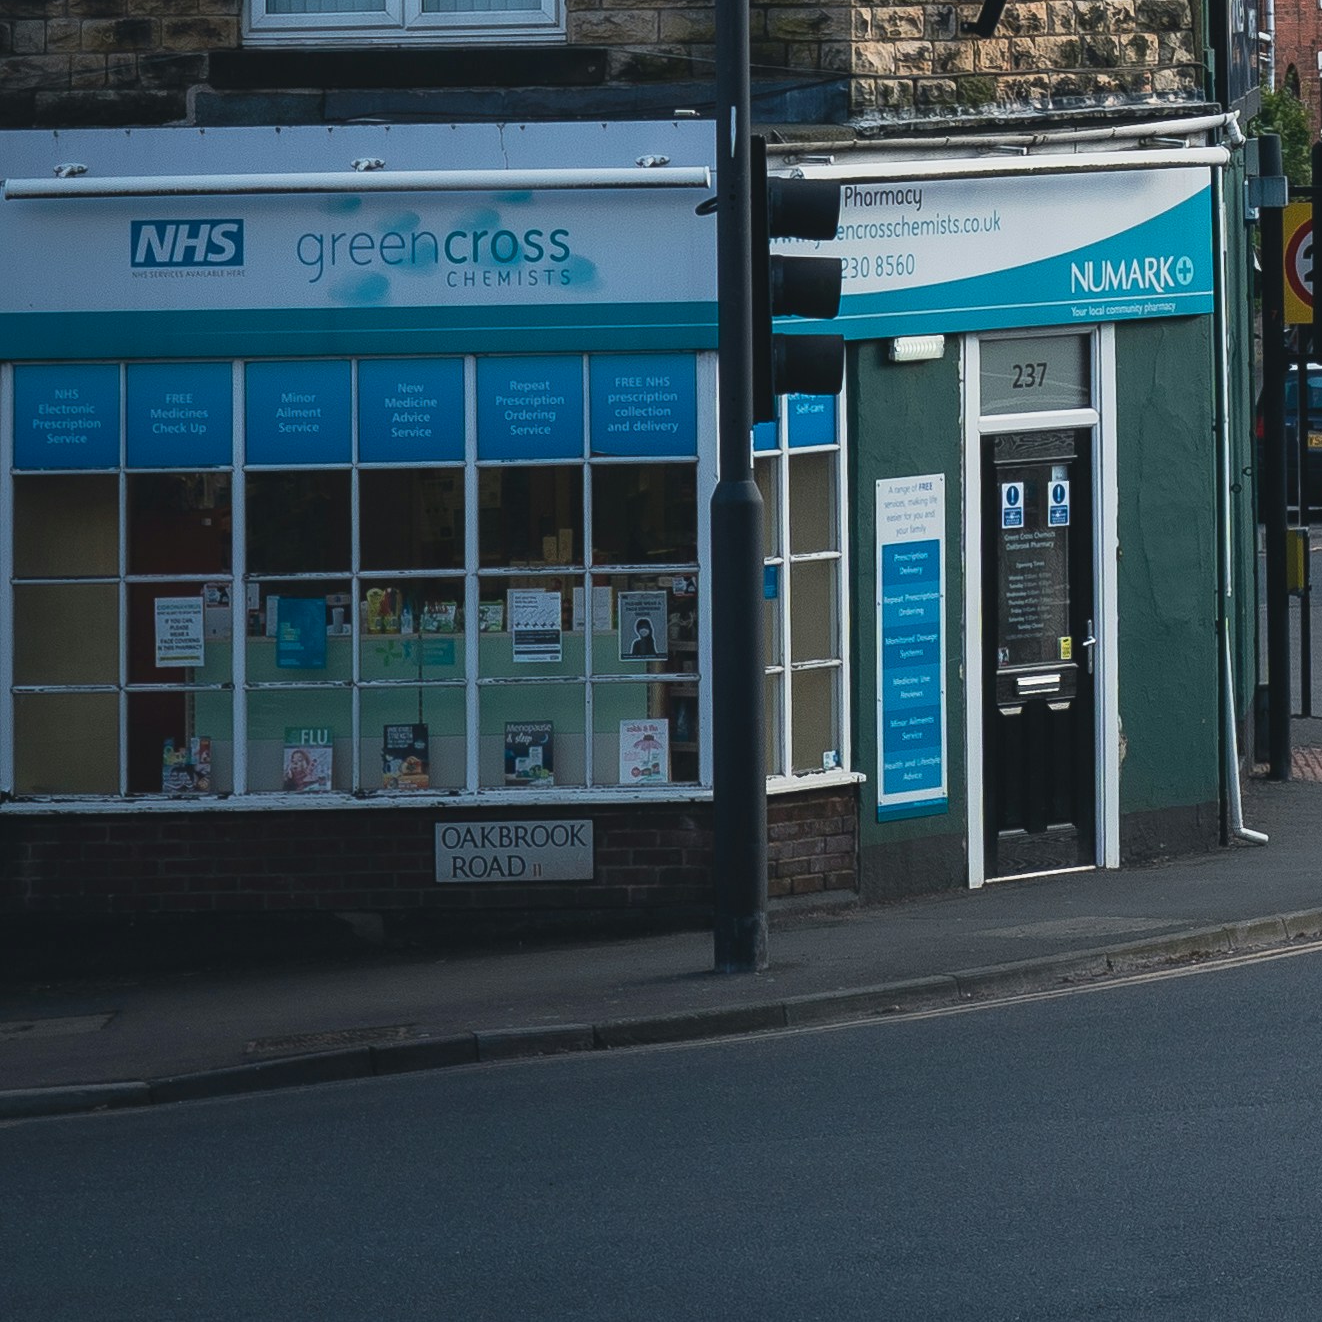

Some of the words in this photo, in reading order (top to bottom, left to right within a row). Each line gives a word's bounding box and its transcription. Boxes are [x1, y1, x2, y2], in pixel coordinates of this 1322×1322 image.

[844, 186, 922, 210] Pharmacy
[134, 223, 239, 263] NHS
[297, 229, 571, 283] greencross
[875, 254, 915, 278] 8560
[132, 270, 149, 278] NHS
[150, 270, 184, 278] SERVICES
[185, 270, 224, 278] AVAILABLE
[226, 269, 245, 277] HERE
[446, 269, 572, 287] CHEMISTS
[1071, 256, 1175, 294] NUMARK
[1071, 306, 1087, 317] Your
[1089, 305, 1104, 315] local
[1106, 304, 1142, 315] community
[1144, 302, 1176, 313] pharmacy
[1013, 363, 1048, 389] 237
[510, 381, 550, 392] Repeat
[616, 377, 642, 387] FREE
[646, 377, 670, 387] NHS
[55, 389, 79, 399] NHS
[398, 384, 424, 393] New
[166, 394, 193, 404] FREE
[281, 393, 316, 403] Minor
[385, 398, 437, 408] Medicine
[496, 395, 564, 407] Prescription
[608, 392, 678, 404] prescription
[38, 404, 95, 414] Electronic
[150, 408, 208, 419] Medicines
[276, 408, 321, 418] Ailment
[615, 407, 671, 417] collection
[392, 412, 431, 422] Advice
[505, 410, 556, 422] Ordering
[33, 419, 101, 430] Prescription
[153, 423, 186, 433] Check
[190, 424, 207, 434] Up
[278, 422, 319, 433] Service
[510, 425, 551, 435] Service
[608, 422, 629, 432] and
[633, 421, 679, 433] delivery
[391, 427, 432, 437] Service
[47, 434, 87, 444] Service
[919, 482, 933, 491] FREE
[894, 551, 928, 563] Prescription
[900, 565, 923, 575] Delivery
[884, 595, 904, 604] Repeat
[905, 591, 939, 603] Prescription
[899, 608, 925, 617] Ordering
[885, 634, 915, 645] Monitored
[916, 633, 938, 643] Dosage
[890, 718, 908, 727] Minor
[506, 723, 552, 734] Menopause
[301, 729, 328, 745] FLU
[506, 735, 513, 743] &
[902, 731, 923, 740] Service
[885, 761, 904, 770] Health
[905, 759, 916, 767] and
[917, 756, 941, 766] Lifestyle
[903, 772, 923, 781] Advice
[441, 824, 586, 849] OAKBROOK
[452, 855, 525, 878] ROAD
